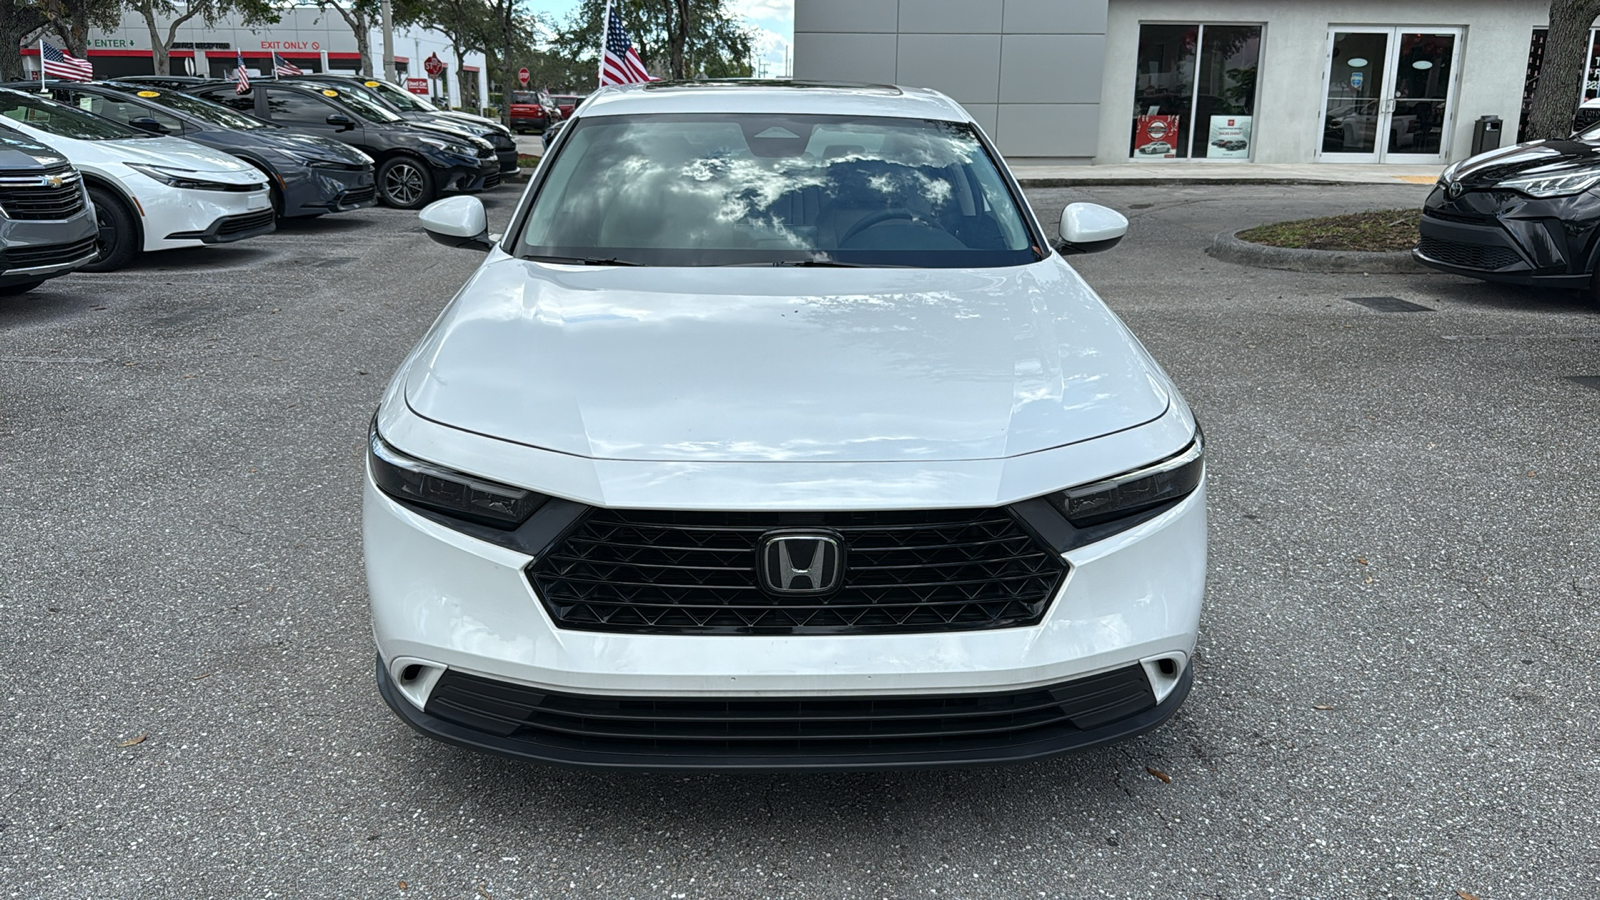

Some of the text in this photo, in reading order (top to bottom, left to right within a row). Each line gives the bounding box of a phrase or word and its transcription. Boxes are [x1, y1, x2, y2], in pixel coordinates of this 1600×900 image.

[94, 39, 127, 48] ENTER
[261, 41, 308, 50] EXIT ONLY
